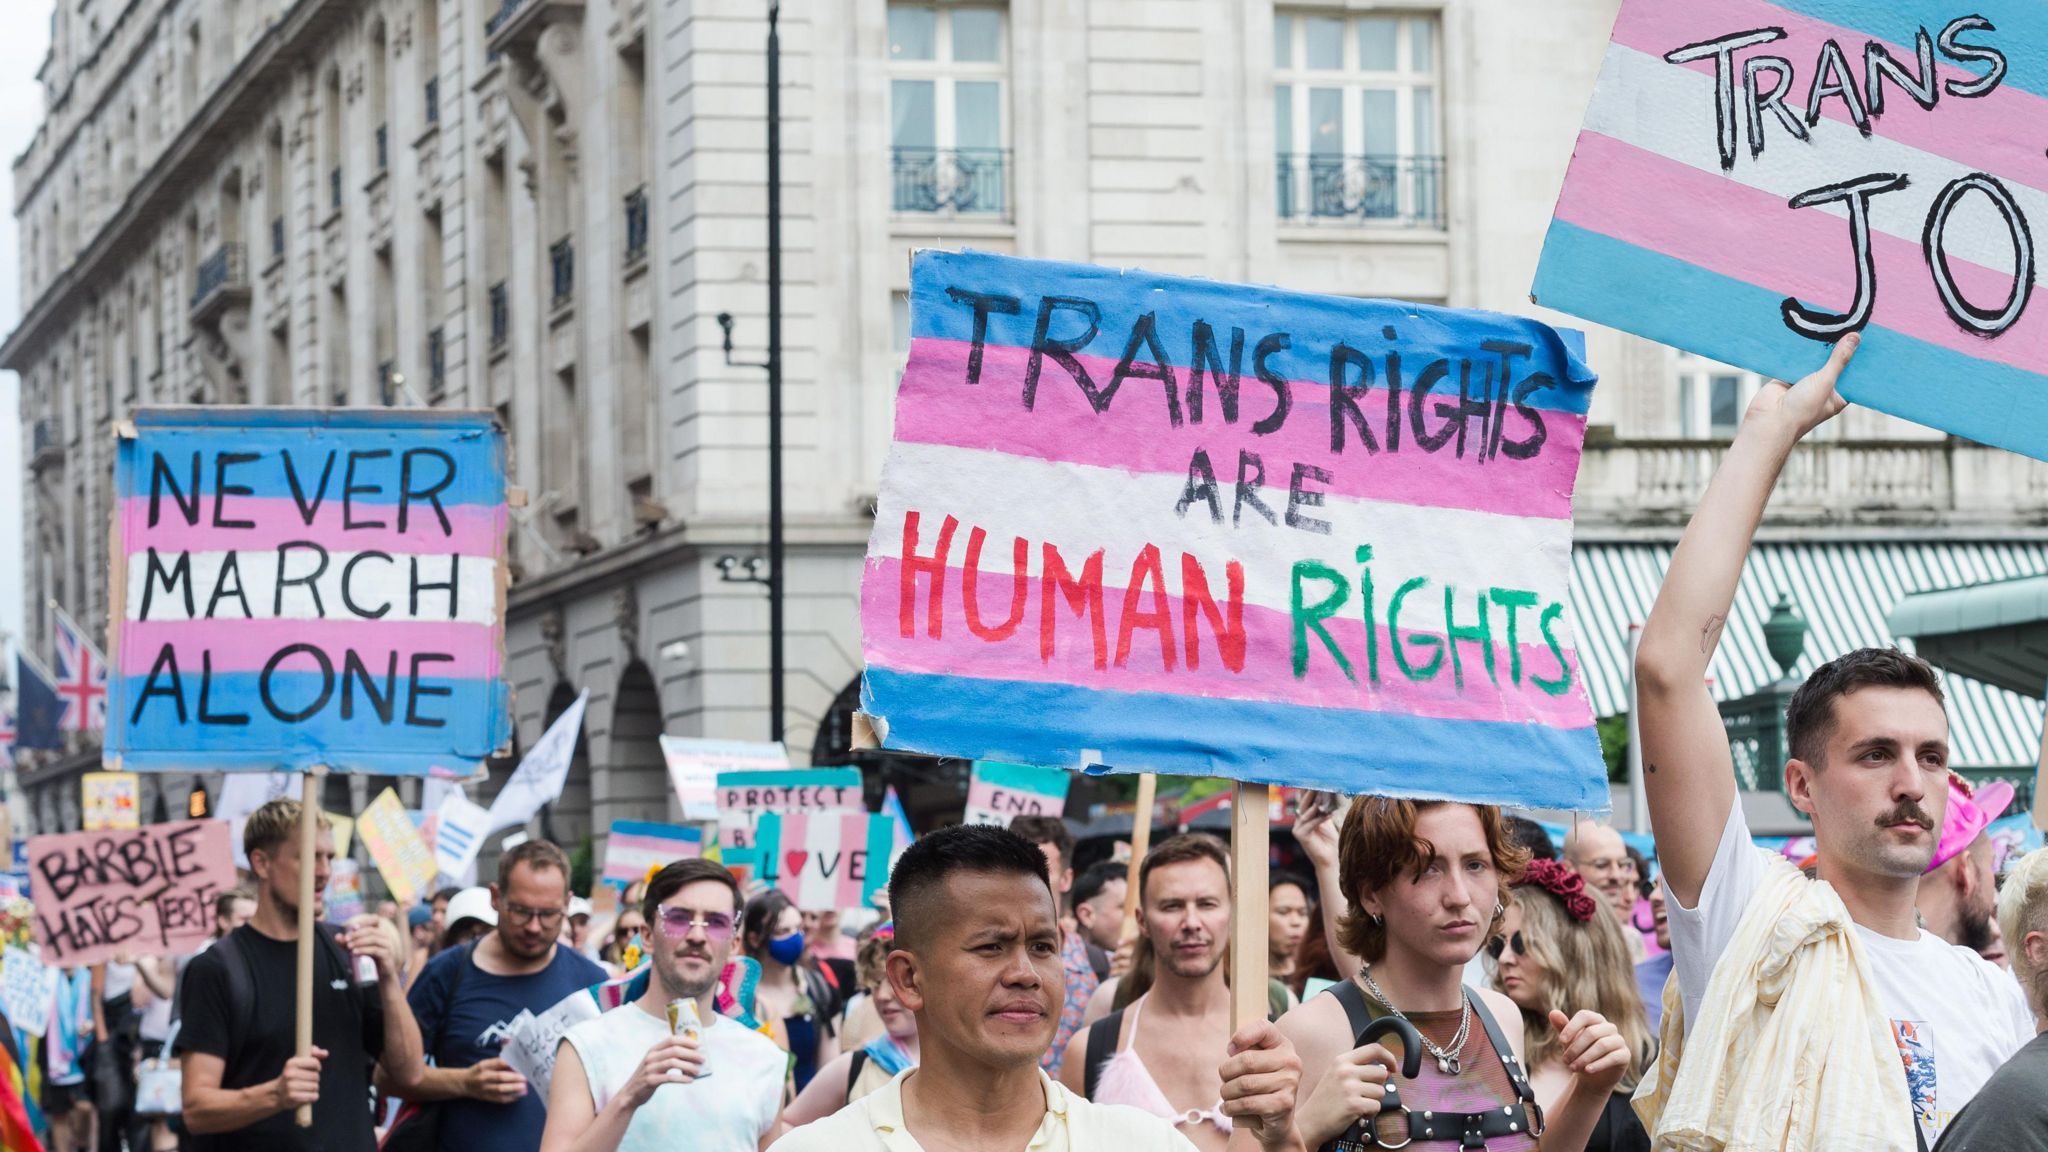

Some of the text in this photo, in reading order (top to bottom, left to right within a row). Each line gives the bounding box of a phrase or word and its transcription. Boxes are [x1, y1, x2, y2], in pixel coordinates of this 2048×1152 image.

[1663, 13, 2007, 174] TRANS
[1780, 148, 2048, 347] JO
[944, 286, 1292, 436] TRANS
[147, 447, 457, 537] NEVER
[1174, 447, 1335, 535] ARE
[138, 540, 460, 621] MARCH
[898, 510, 1247, 675] HUMAN
[131, 642, 455, 728] ALONE
[726, 786, 847, 808] PROTECT
[991, 790, 1043, 816] END
